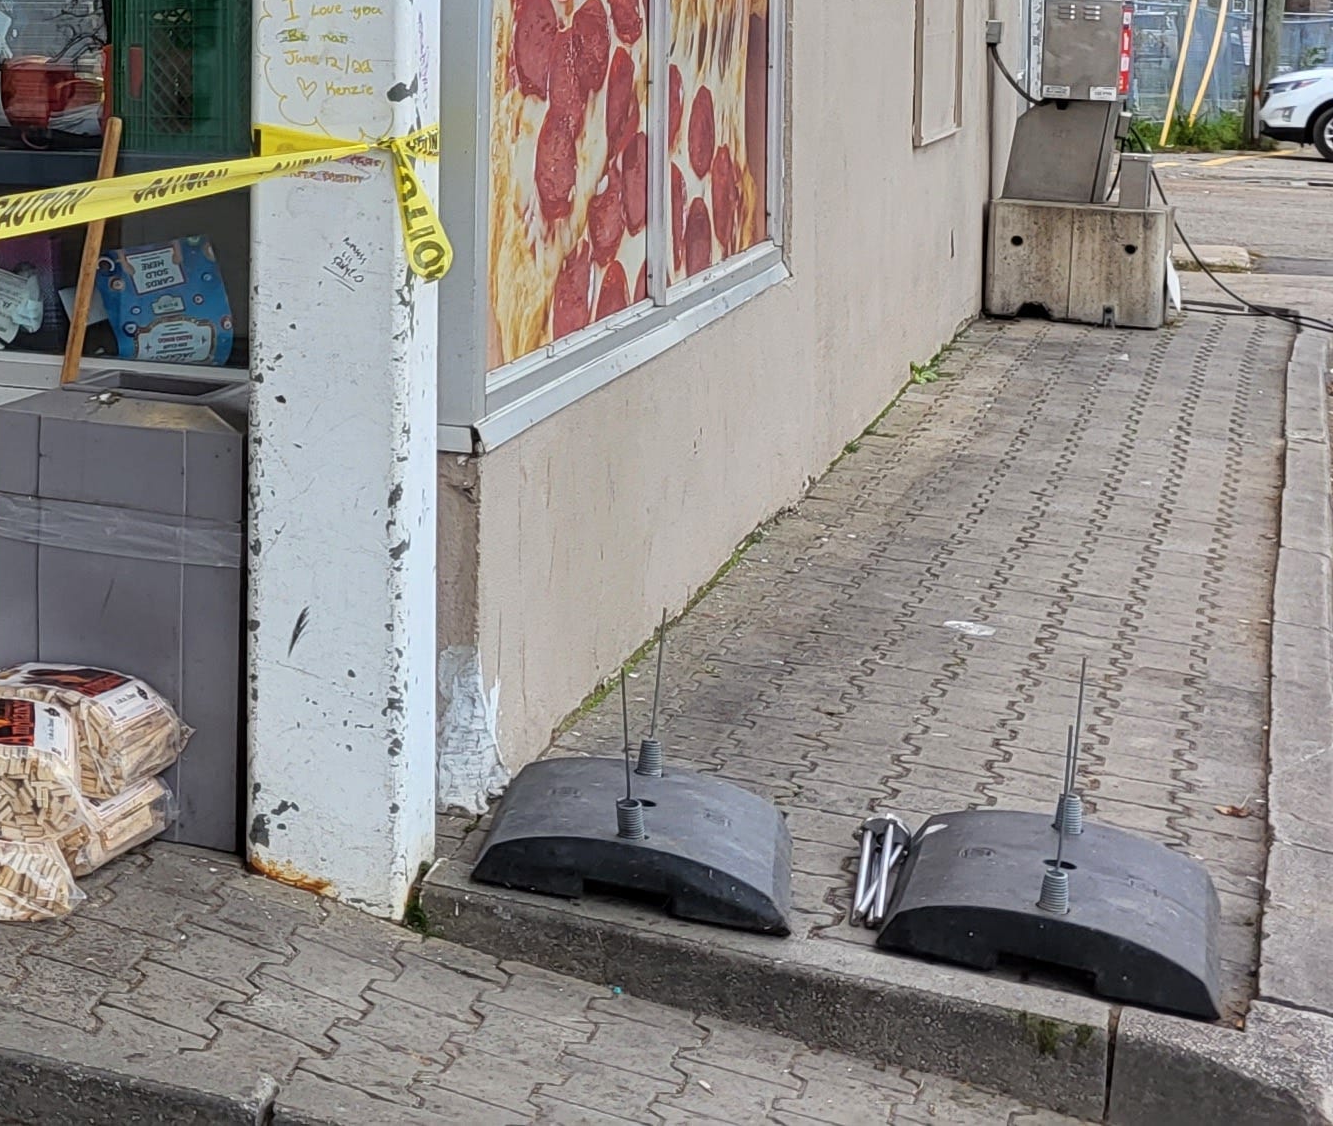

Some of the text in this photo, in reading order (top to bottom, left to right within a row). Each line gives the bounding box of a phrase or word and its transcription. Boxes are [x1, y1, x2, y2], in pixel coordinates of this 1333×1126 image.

[325, 80, 374, 96] Kenzie
[141, 259, 165, 271] HERE
[145, 268, 169, 279] SOLD
[145, 276, 175, 289] CARDS
